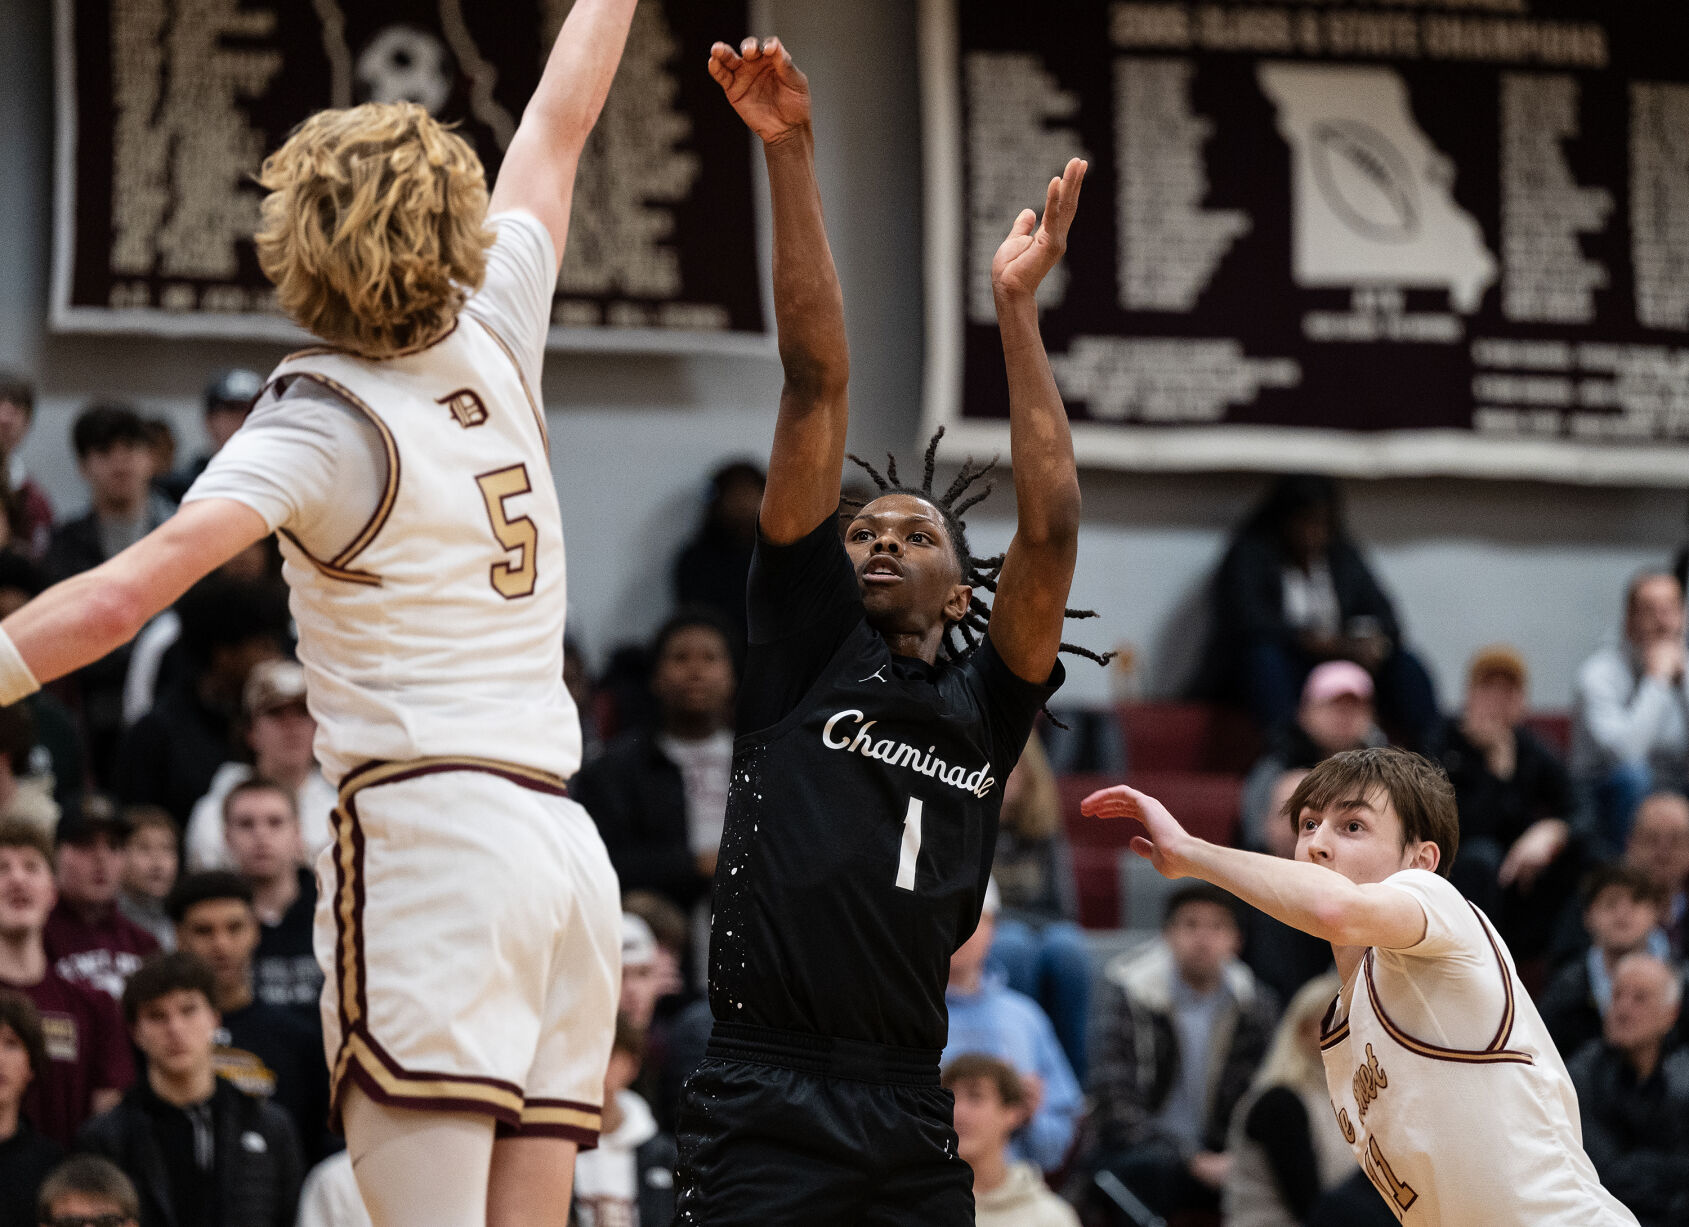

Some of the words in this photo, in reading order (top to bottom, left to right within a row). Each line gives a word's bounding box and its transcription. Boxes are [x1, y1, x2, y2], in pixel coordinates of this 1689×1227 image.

[475, 462, 538, 600] 5
[822, 709, 995, 799] Chaminade
[896, 796, 924, 892] 1
